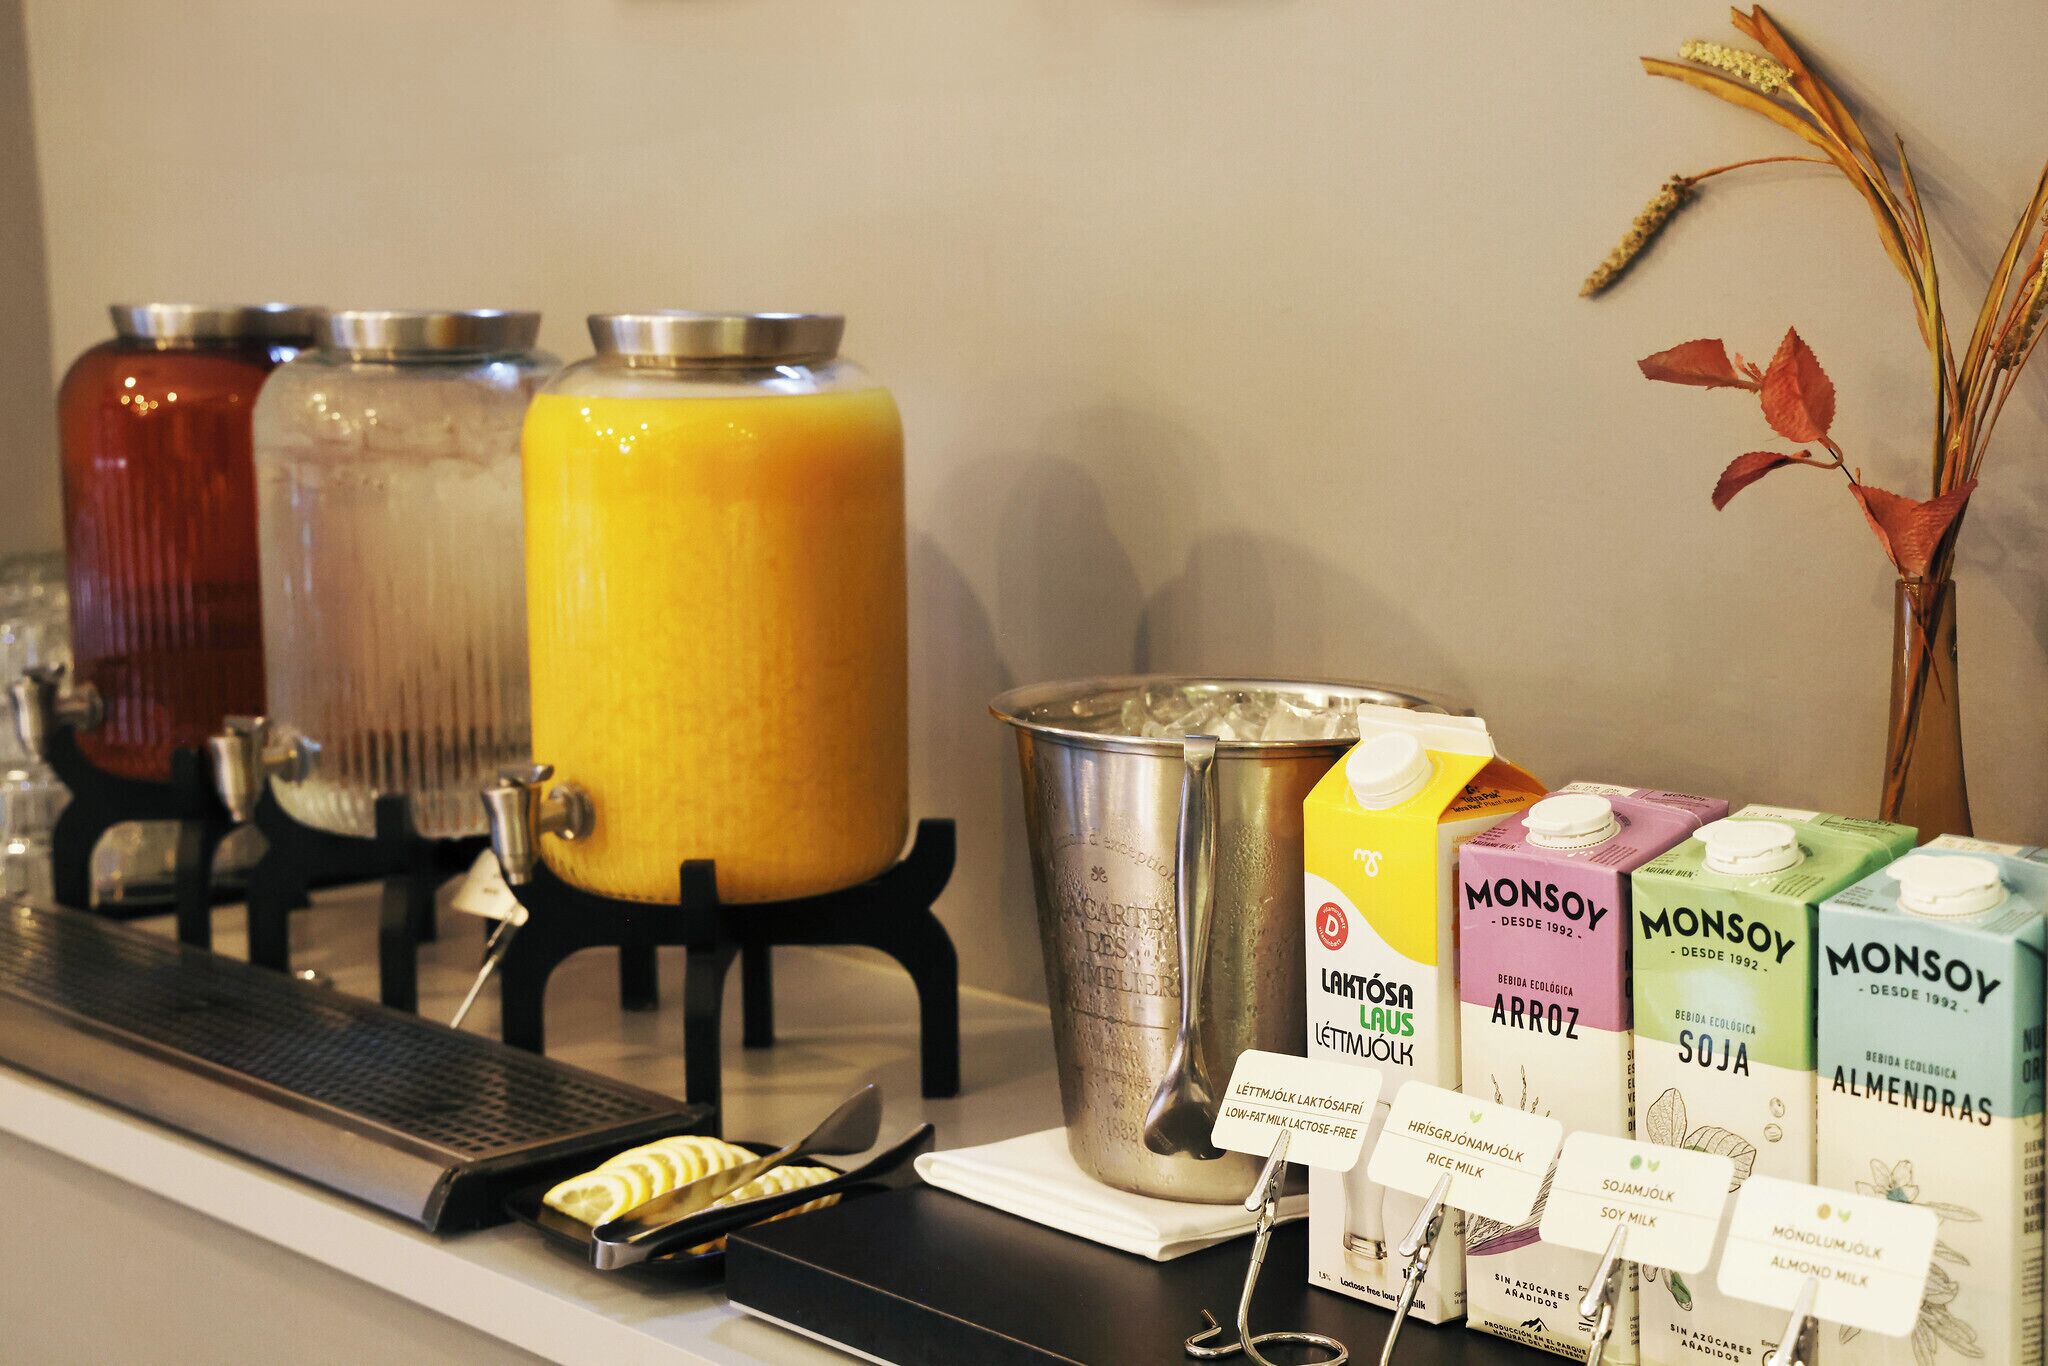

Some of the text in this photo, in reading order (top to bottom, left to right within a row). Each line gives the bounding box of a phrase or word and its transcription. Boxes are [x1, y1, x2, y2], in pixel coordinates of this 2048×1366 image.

[1464, 877, 1609, 932] MONSOY
[1324, 913, 1340, 938] D
[1501, 916, 1574, 939] DESDE 1992
[1638, 906, 1796, 964] MONSOY
[1086, 930, 1129, 960] DES
[1680, 945, 1759, 972] DESDE 1992
[1321, 967, 1414, 1010] LAKTÓSA
[1498, 973, 1574, 998] BEBIDA ECOLÓGICA
[1825, 941, 2001, 1005] MONSOY
[1869, 983, 1958, 1013] DESDE 1992
[1359, 1003, 1415, 1037] LAUS
[1491, 992, 1581, 1040] ARROZ
[1674, 1008, 1757, 1036] BEBIDA ECOLÓGICA
[1315, 1021, 1415, 1067] LÉTTMJÓLK
[1678, 1029, 1750, 1078] SOJA
[1865, 1050, 1958, 1081] BEBIDA ECOLÓGICA
[1236, 1081, 1364, 1116] LÉTTMJÓLK LAKTÓSAFRÍ
[1832, 1064, 1993, 1127] ALMENDRAS
[1225, 1106, 1359, 1140] LOW-FAT MILK LACTOSE-FREE
[1407, 1119, 1525, 1163] HRÍSGRJÓNAMJÓLK
[1426, 1152, 1485, 1179] RICE MILK
[1602, 1178, 1676, 1203] SOJAMJÓLK
[1600, 1206, 1659, 1229] SOY MILK
[1770, 1255, 1870, 1288] ALMOND MILK
[1340, 1277, 1366, 1293] Lactose
[1366, 1285, 1381, 1297] free
[1382, 1290, 1396, 1302] low
[1494, 1273, 1512, 1285] SIN
[1515, 1279, 1571, 1302] AZÚCARES
[1505, 1287, 1559, 1310] AÑADIDOS
[1484, 1320, 1588, 1356] PRODUCCIÓN EN EL PARQUE
[1492, 1329, 1527, 1344] NATURAL
[1528, 1338, 1543, 1349] DEL
[1670, 1323, 1688, 1337] SIN
[1692, 1331, 1753, 1356] AZÚCARES
[1681, 1339, 1740, 1364] AÑADIDOS
